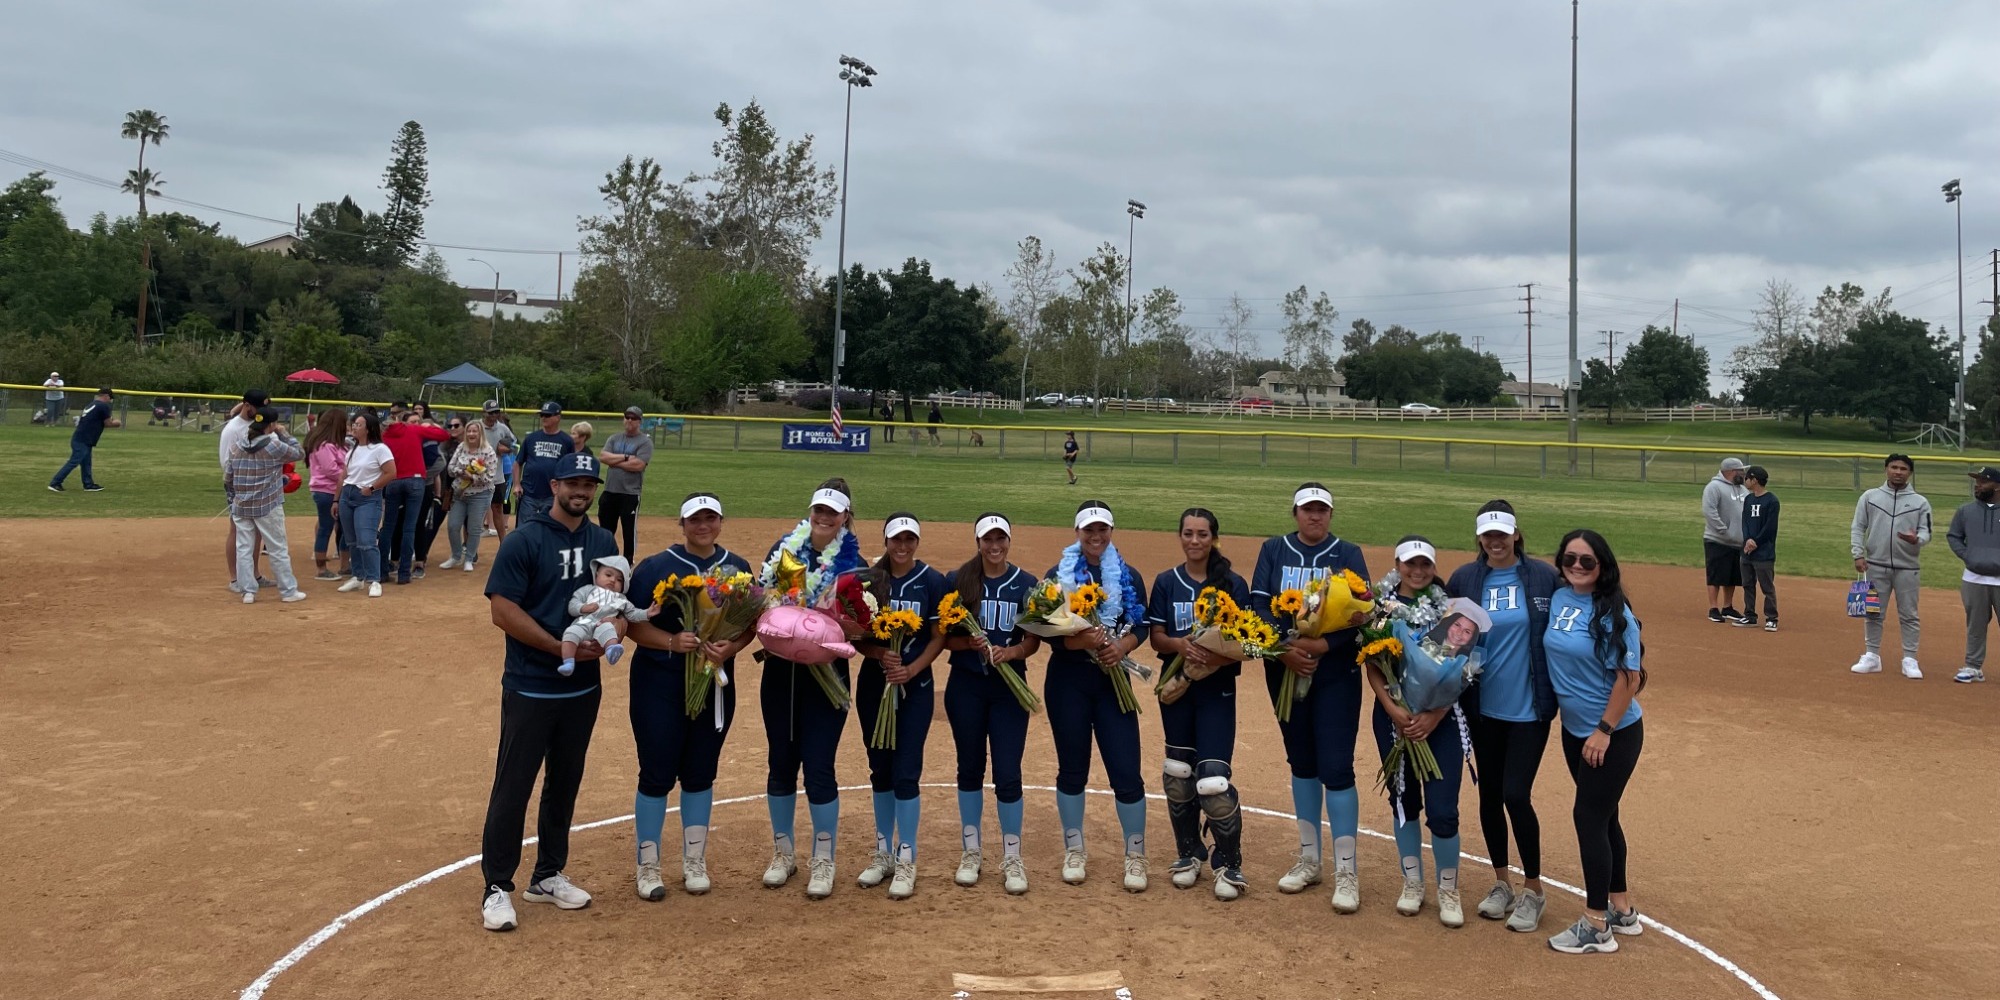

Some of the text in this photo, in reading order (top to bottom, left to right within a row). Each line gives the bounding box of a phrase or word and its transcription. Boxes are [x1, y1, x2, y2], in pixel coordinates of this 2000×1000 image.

[787, 430, 804, 445] H
[851, 432, 867, 447] H
[575, 455, 593, 471] H
[1750, 504, 1761, 517] H
[558, 547, 584, 580] H
[1486, 585, 1520, 612] H
[1847, 601, 1867, 616] 2023
[1551, 605, 1582, 632] H
